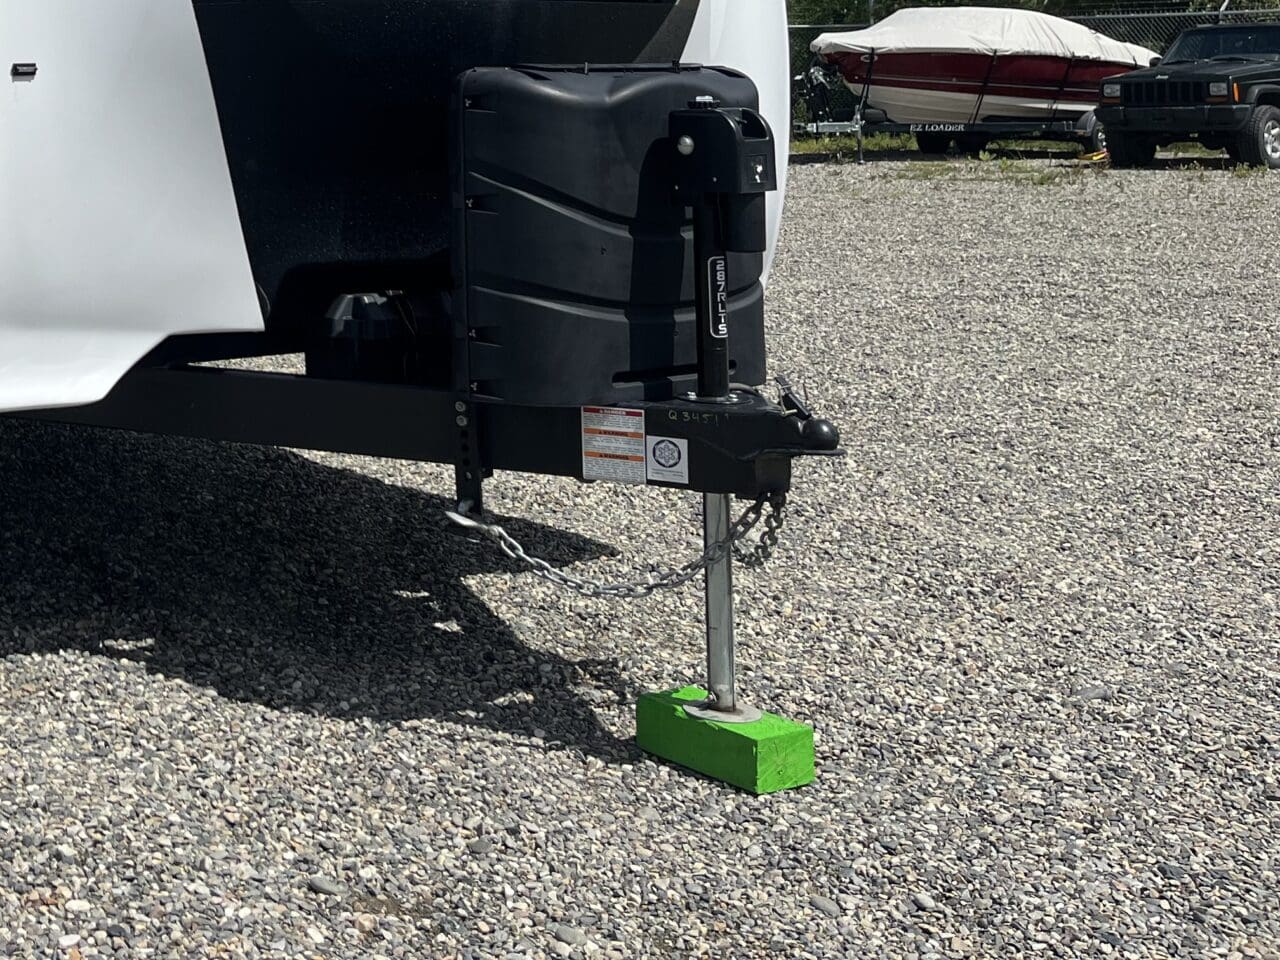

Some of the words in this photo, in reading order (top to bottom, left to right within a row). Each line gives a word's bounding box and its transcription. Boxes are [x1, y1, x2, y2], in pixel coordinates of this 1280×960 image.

[910, 124, 923, 132] EZ
[925, 124, 965, 132] LOADER
[716, 260, 728, 335] 287RLTS
